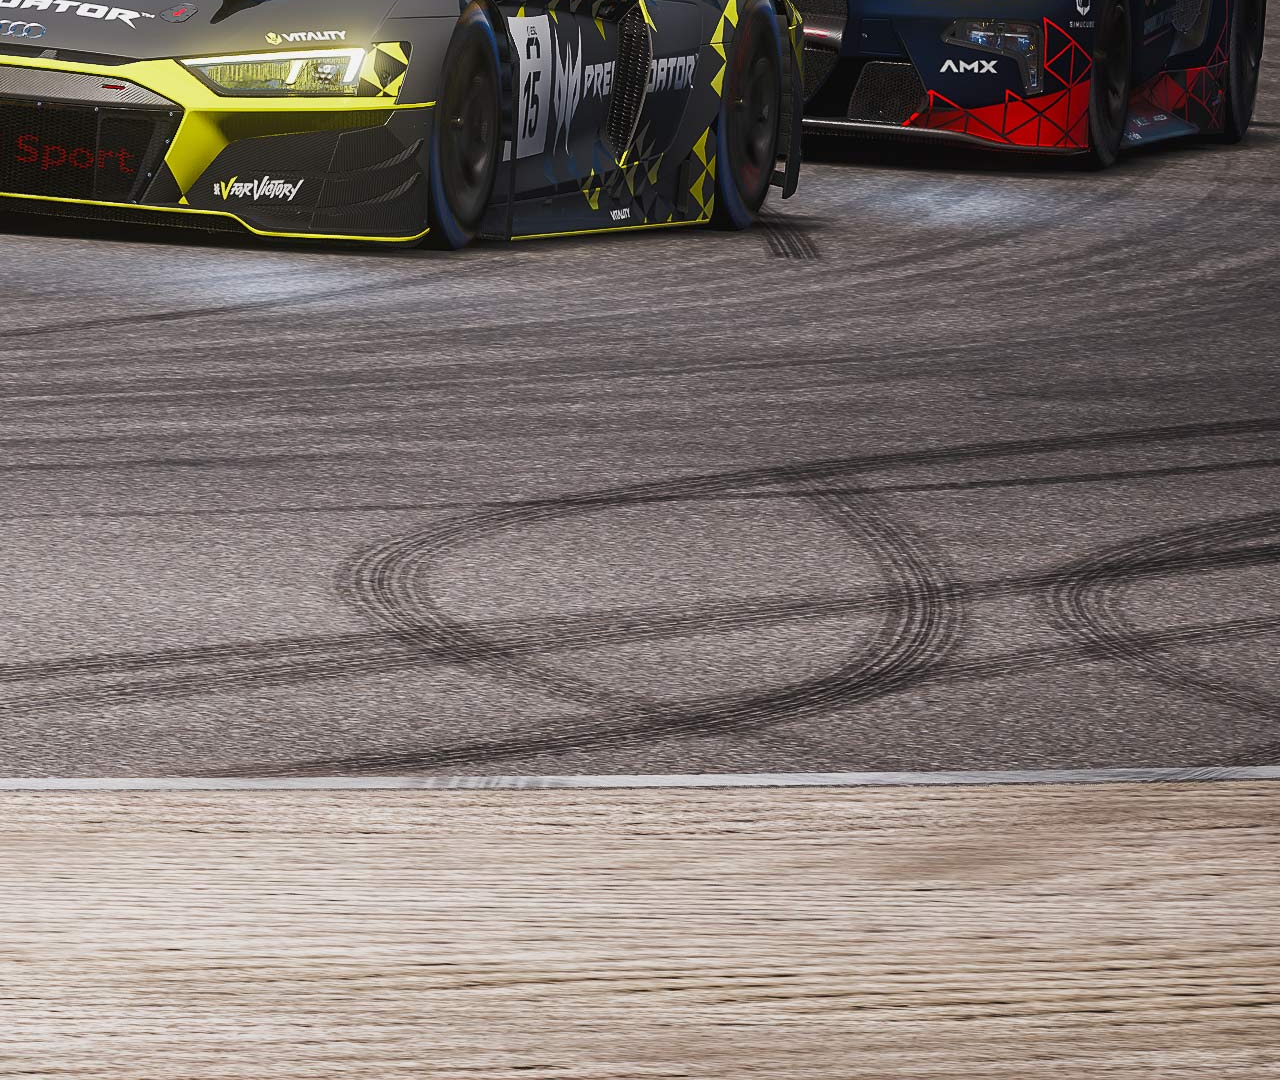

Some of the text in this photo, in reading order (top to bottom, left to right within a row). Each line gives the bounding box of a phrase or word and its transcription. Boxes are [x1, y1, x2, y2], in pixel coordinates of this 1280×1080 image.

[282, 30, 347, 42] VITALITY
[940, 59, 998, 74] AMX
[521, 70, 542, 140] 15
[15, 133, 135, 174] Sport
